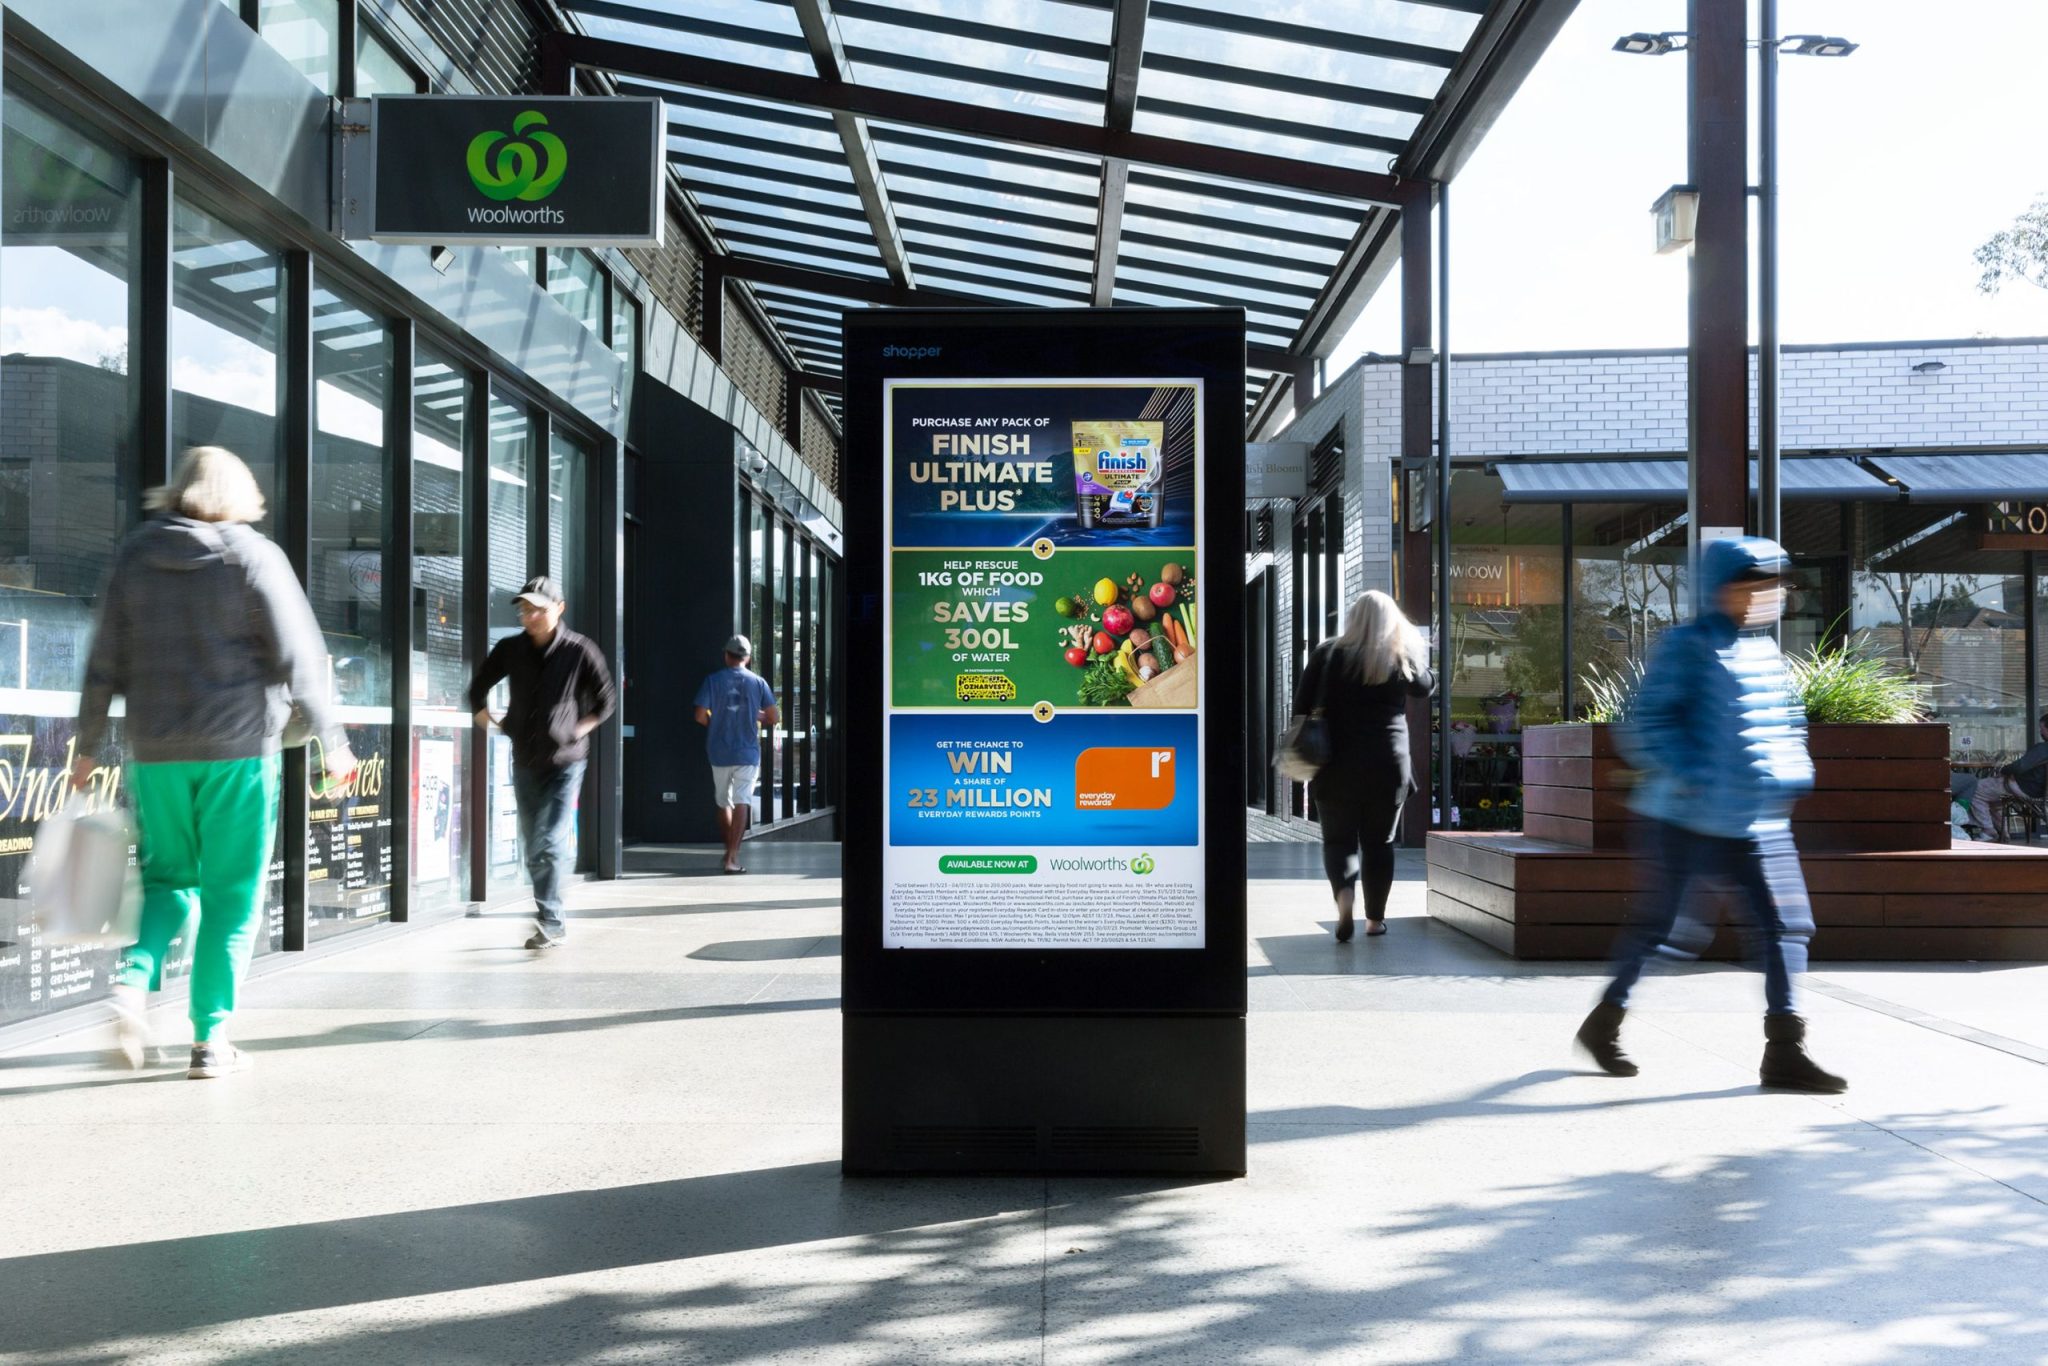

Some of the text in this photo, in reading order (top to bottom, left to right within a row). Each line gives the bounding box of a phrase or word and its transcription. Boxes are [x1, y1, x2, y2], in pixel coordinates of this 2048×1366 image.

[467, 206, 564, 225] Woolworths
[883, 345, 942, 359] shopper
[912, 418, 1050, 428] PURCHASE ANY PACK OF
[932, 434, 1031, 456] FINISH
[1097, 450, 1147, 470] finish
[910, 462, 1053, 484] ULTIMATE
[944, 560, 1019, 570] HELP RESCUE
[918, 571, 1043, 587] 1KG OF FOOD
[961, 587, 1000, 597] WHICH
[932, 601, 1030, 624] SAVES
[944, 628, 1020, 651] 300L
[952, 652, 1011, 663] OF WATER
[936, 740, 1024, 749] GET THE CHANCE TO
[946, 751, 1013, 775] WIN
[954, 778, 1007, 786] A SHARE OF
[907, 788, 1052, 808] 23 MILLION
[1079, 792, 1116, 803] everyday
[1079, 799, 1113, 807] rewards
[918, 810, 1041, 819] EVERYDAY REWARDS POINTS
[946, 861, 1029, 869] AVAILABLE NOW AT
[1050, 857, 1128, 871] Woolworths
